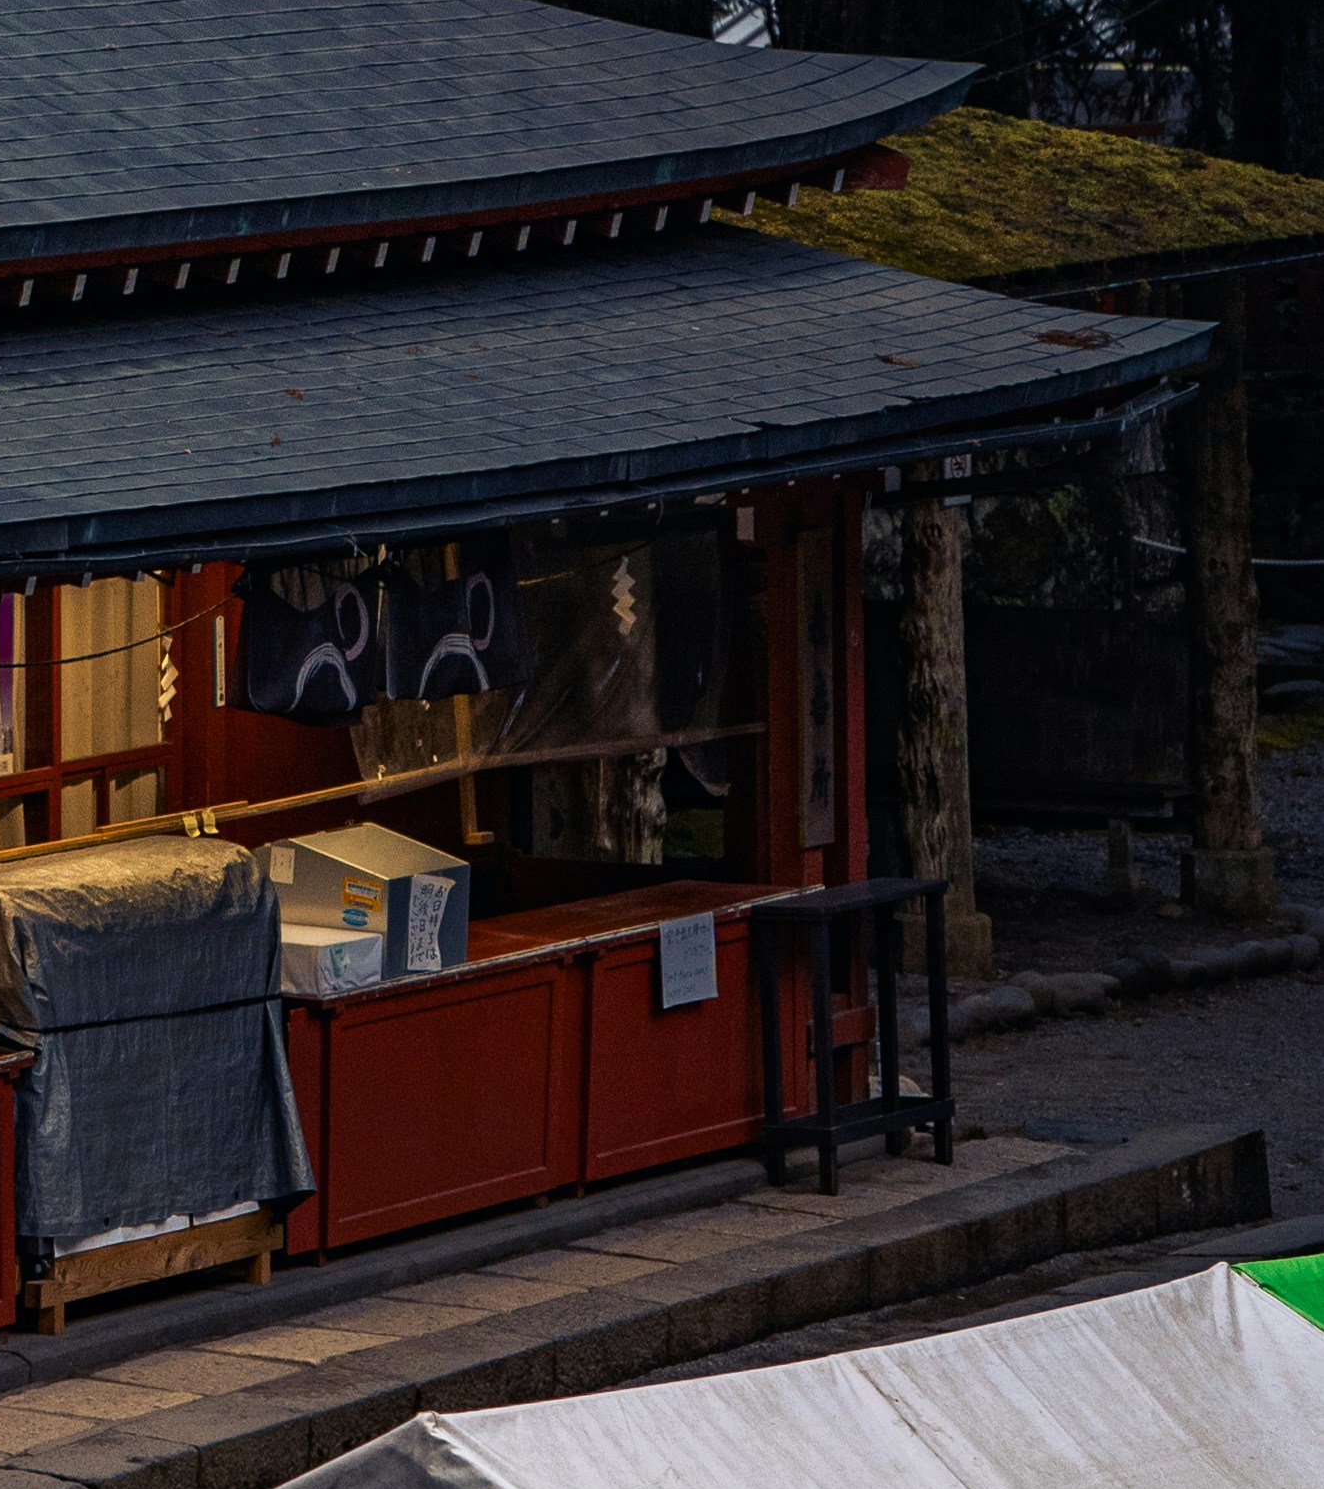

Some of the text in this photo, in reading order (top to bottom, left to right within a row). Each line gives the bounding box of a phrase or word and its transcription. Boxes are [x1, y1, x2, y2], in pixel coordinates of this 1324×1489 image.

[425, 884, 448, 961] お日持ちは
